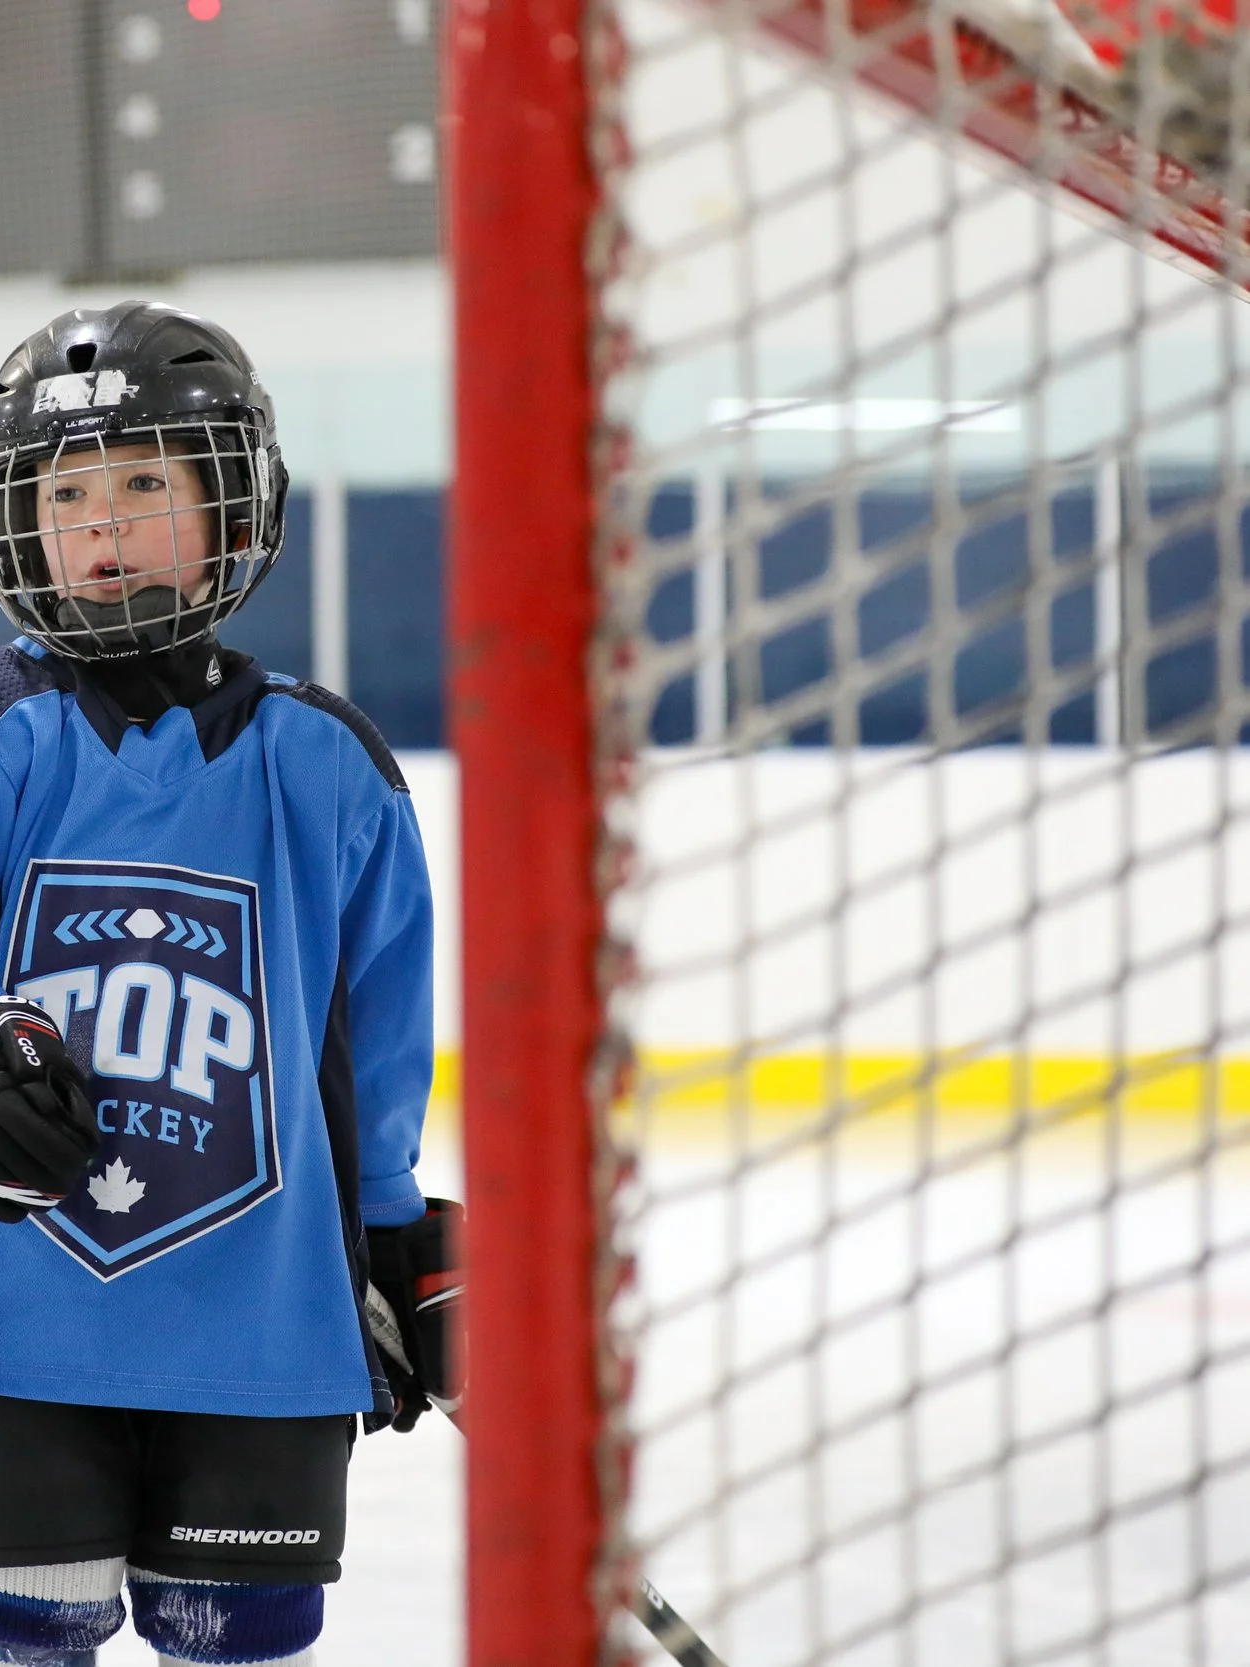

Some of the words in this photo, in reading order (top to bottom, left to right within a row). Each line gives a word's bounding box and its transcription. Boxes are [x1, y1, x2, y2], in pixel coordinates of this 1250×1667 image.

[78, 416, 105, 426] SPORT
[14, 962, 255, 1104] TOP
[96, 1099, 214, 1154] CKEY
[170, 1526, 321, 1545] SHERWOOD
